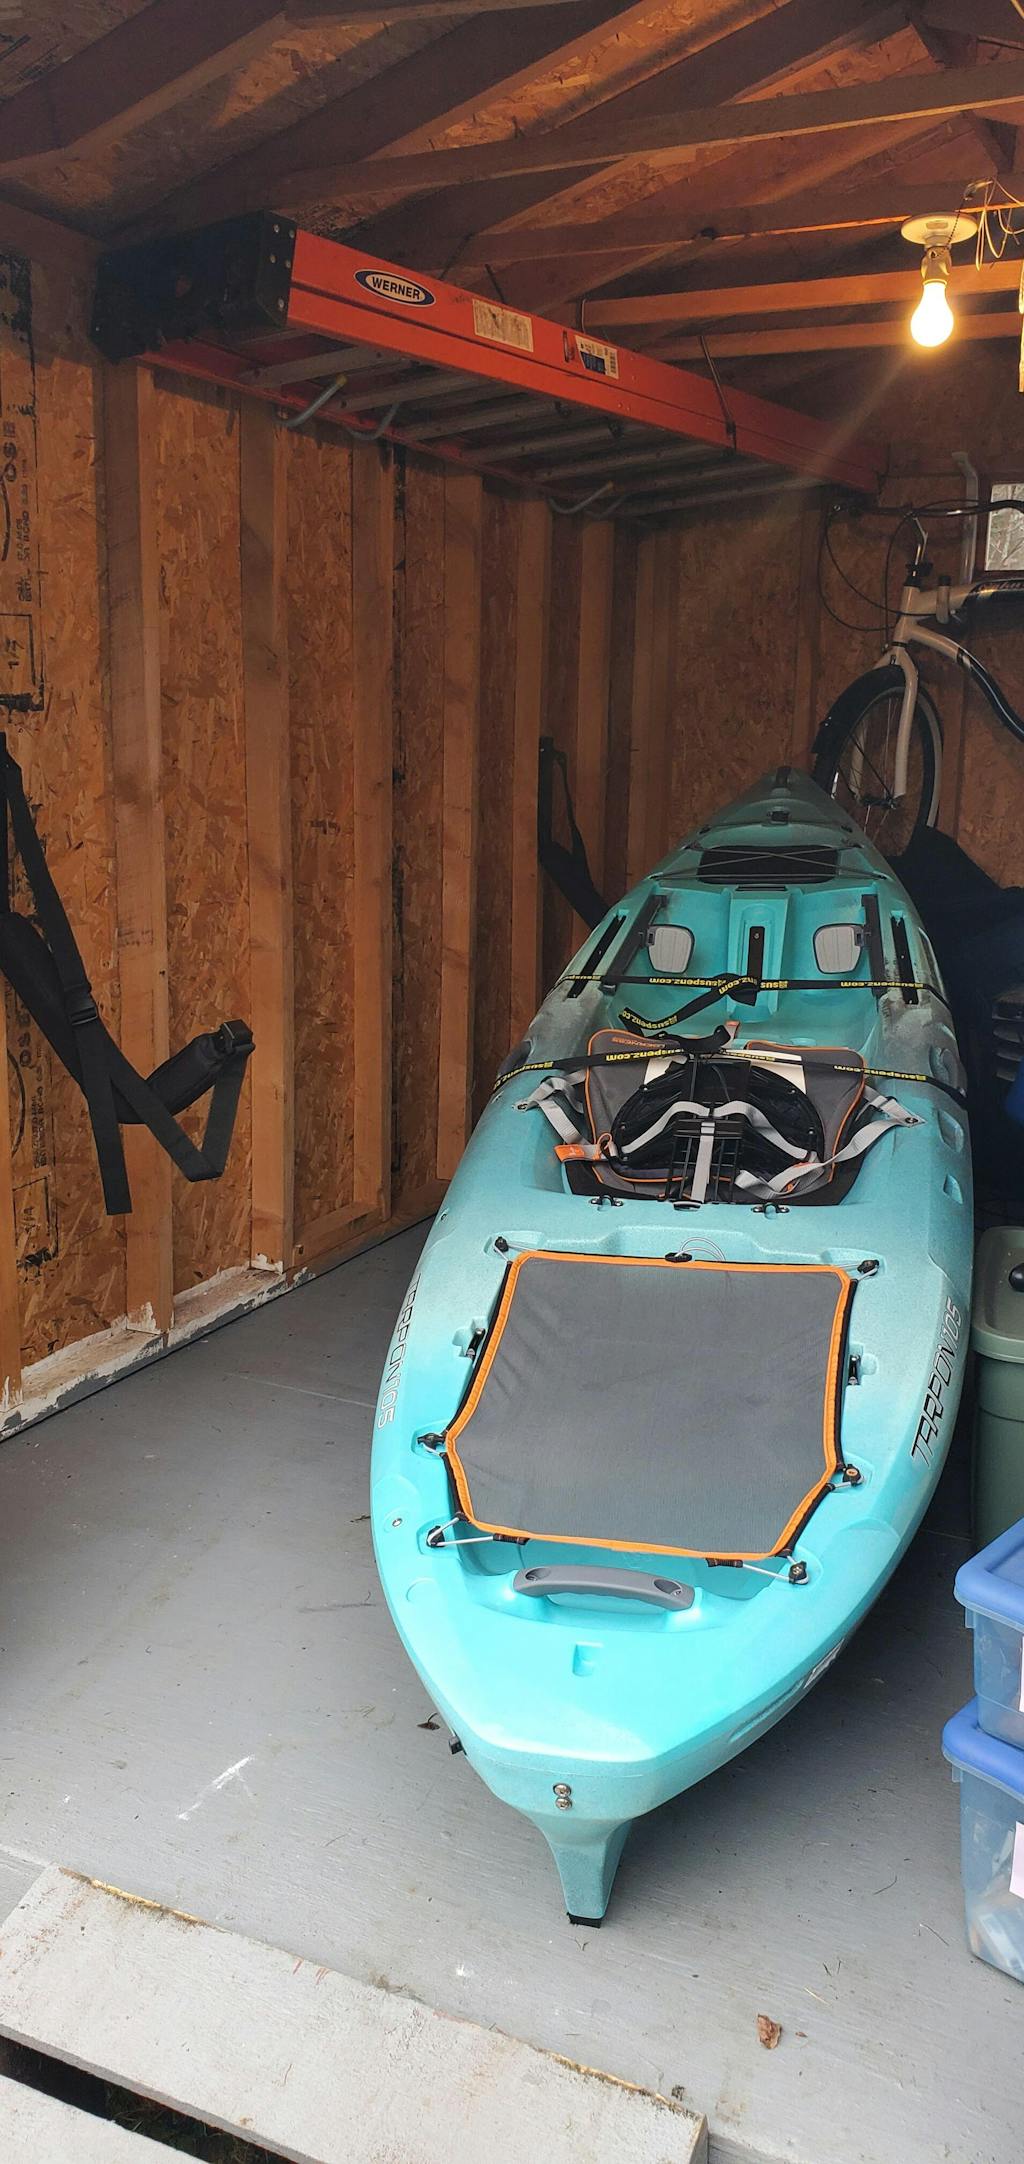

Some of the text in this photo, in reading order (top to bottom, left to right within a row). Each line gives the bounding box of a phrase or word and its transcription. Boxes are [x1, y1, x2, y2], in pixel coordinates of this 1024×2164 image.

[371, 276, 421, 300] WERNER
[649, 977, 718, 987] suspenz.com
[622, 1011, 670, 1029] suspenz.co
[834, 1065, 916, 1080] suspenz.com
